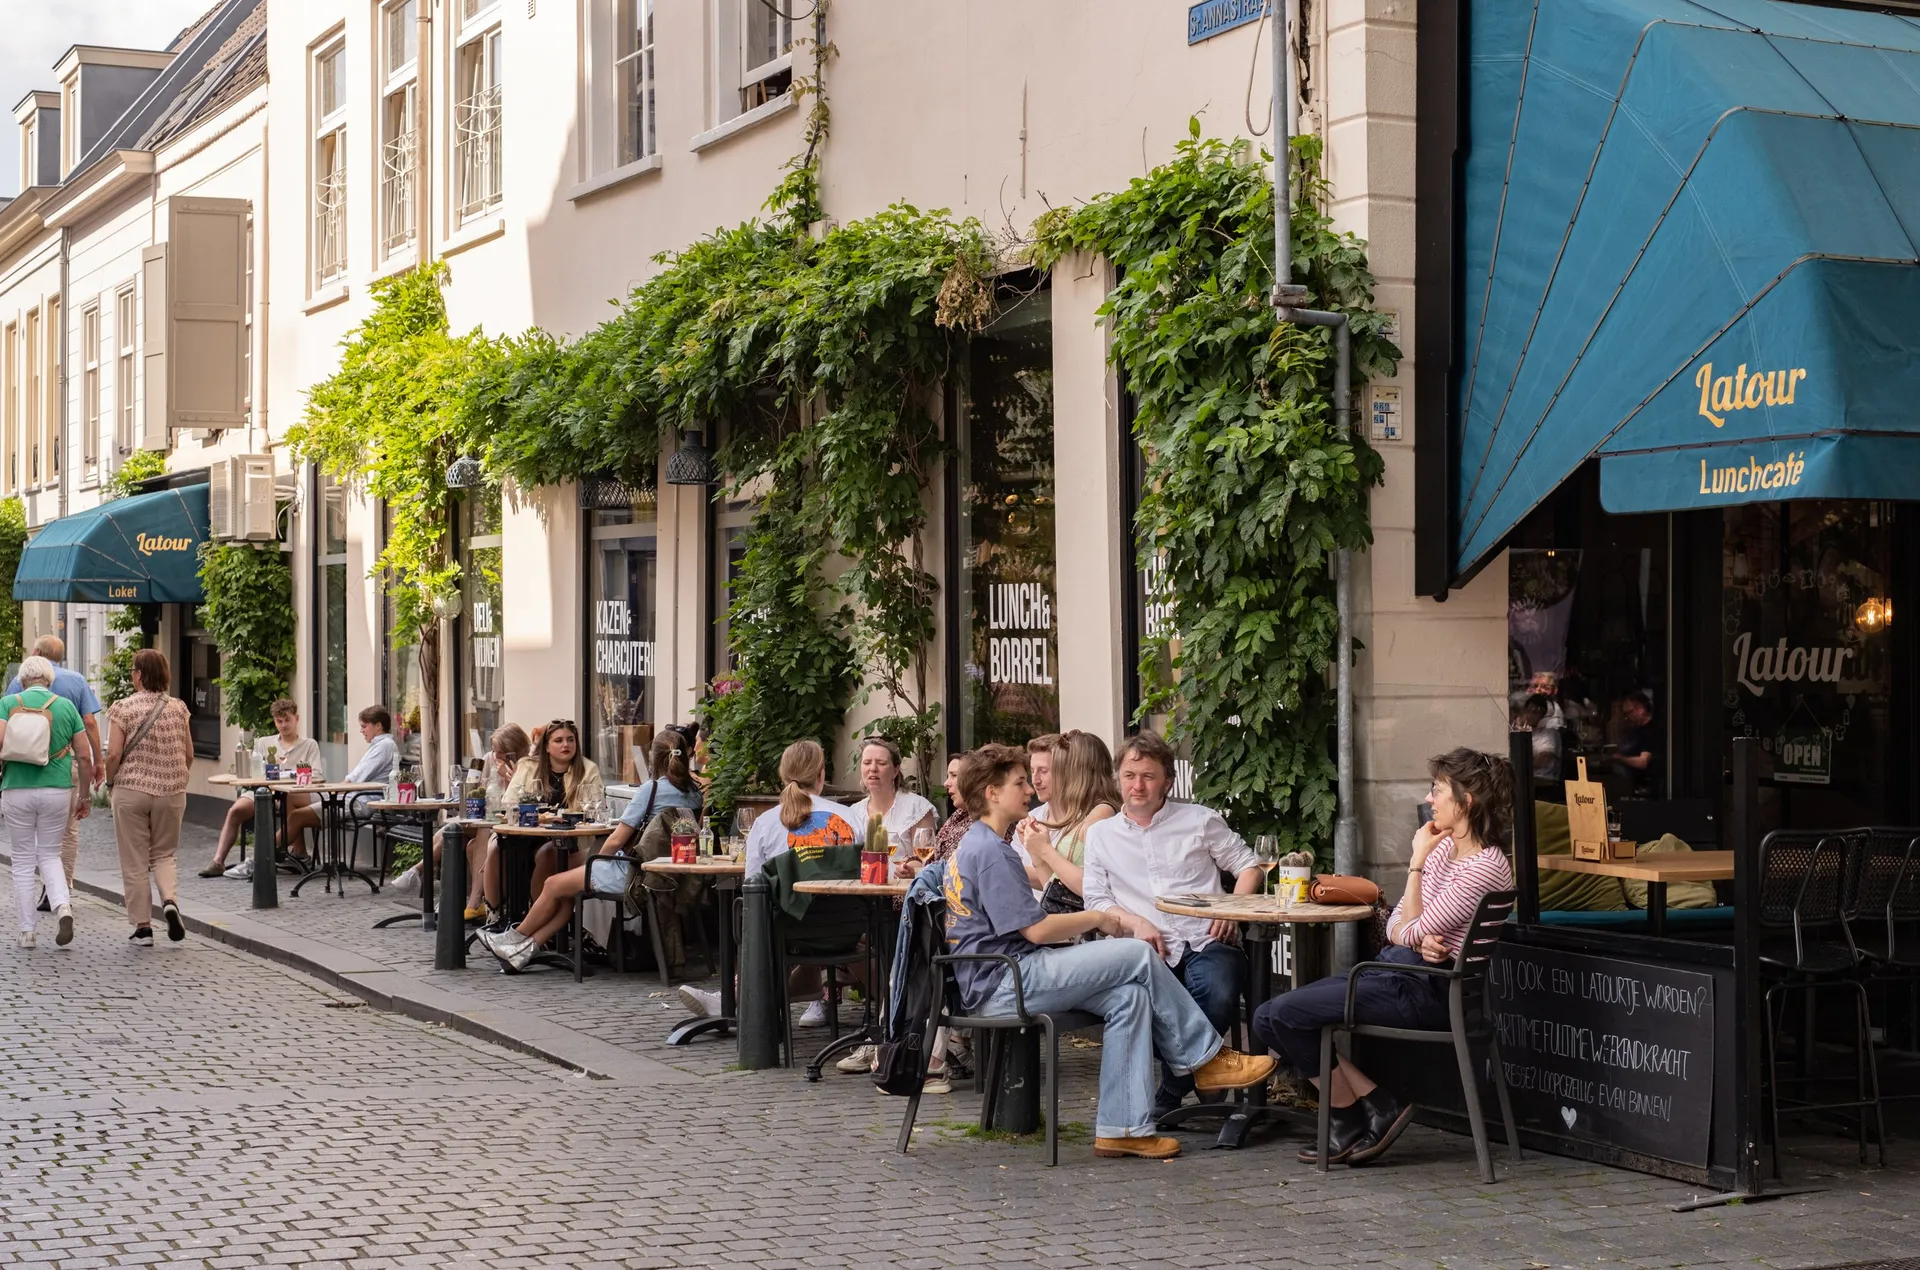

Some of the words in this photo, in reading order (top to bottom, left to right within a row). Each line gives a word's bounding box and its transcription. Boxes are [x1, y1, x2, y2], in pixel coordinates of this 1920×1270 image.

[1695, 362, 1807, 428] Latour
[1700, 450, 1805, 495] Lunchcafé
[136, 532, 193, 557] Latour
[108, 584, 138, 598] Loket
[989, 582, 1051, 630] LUNCH&
[595, 640, 656, 677] CHARCUTERI
[989, 637, 1053, 685] BORREL
[1733, 632, 1854, 697] Latour
[1783, 743, 1822, 767] OPEN
[1574, 793, 1595, 806] Latour
[1516, 960, 1546, 992] OOK
[1551, 967, 1575, 994] EEN
[1581, 971, 1641, 1016] LATOURTJE
[1642, 981, 1707, 1019] WORDEN?
[1598, 1083, 1626, 1111] EVEN
